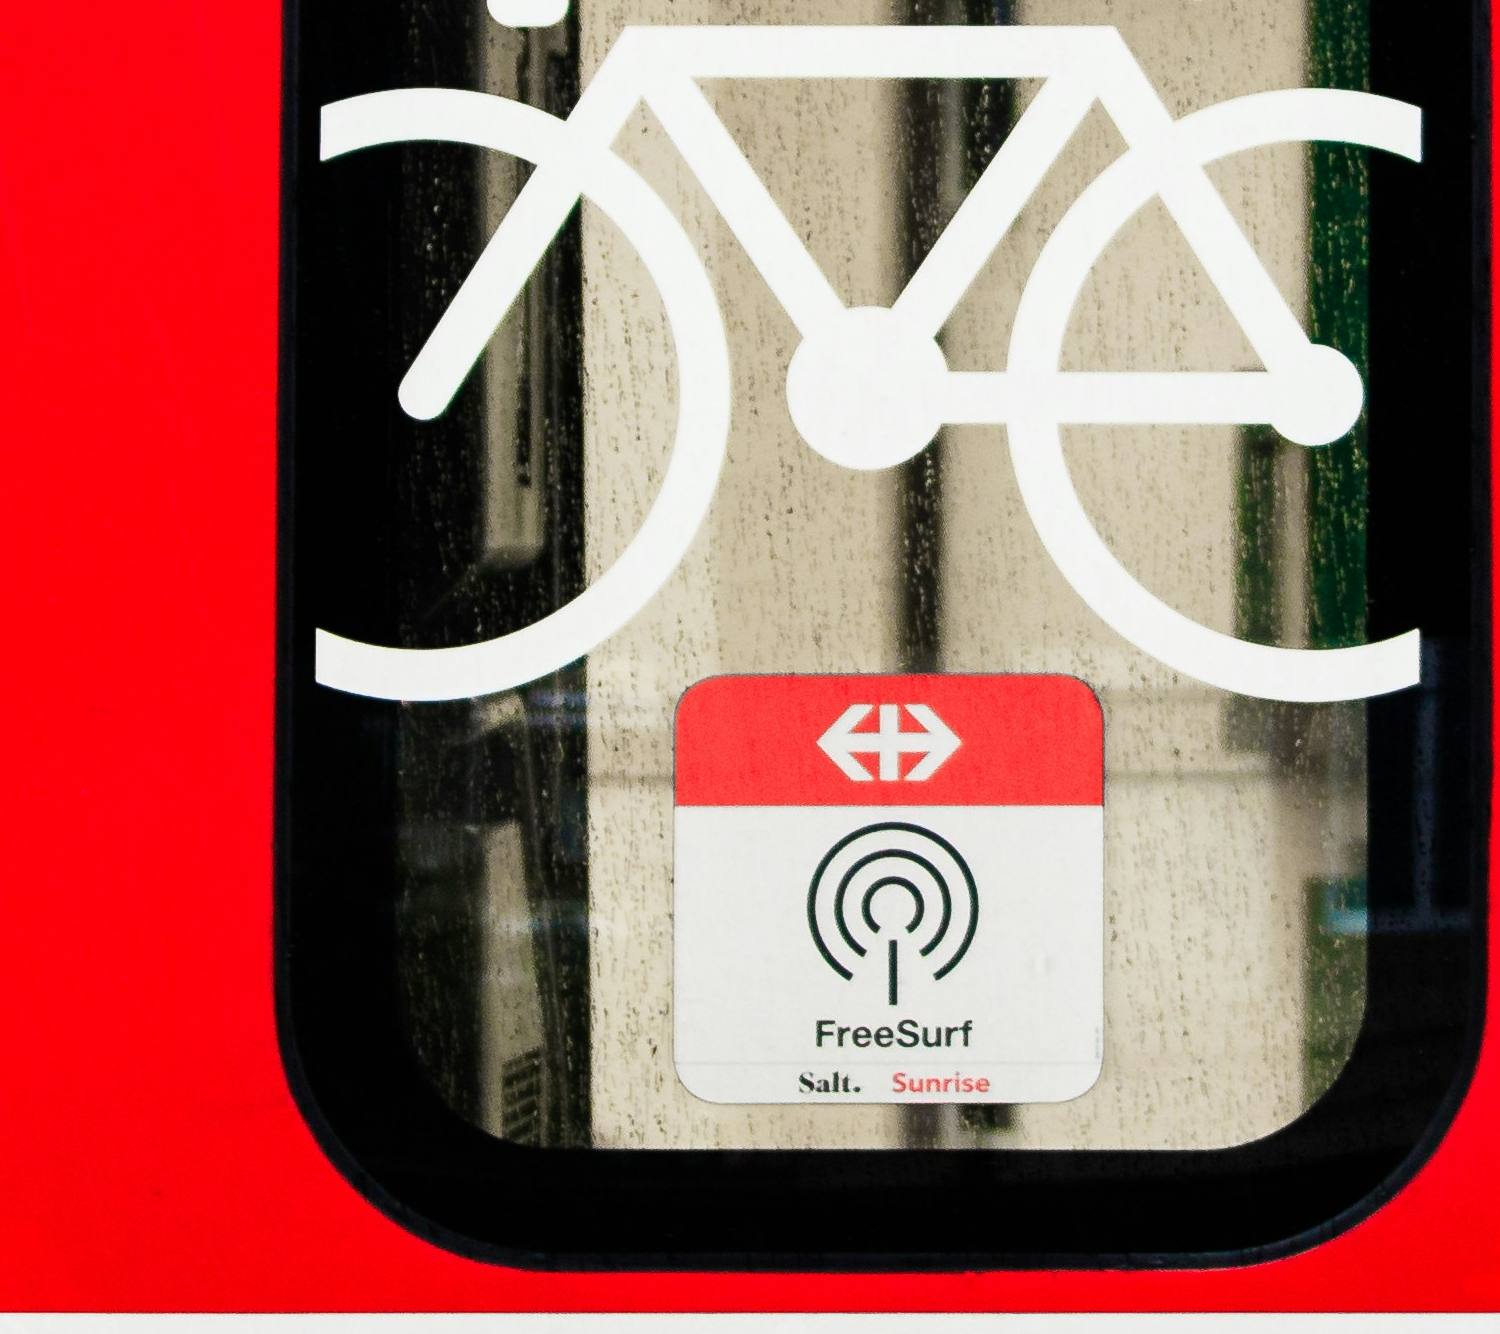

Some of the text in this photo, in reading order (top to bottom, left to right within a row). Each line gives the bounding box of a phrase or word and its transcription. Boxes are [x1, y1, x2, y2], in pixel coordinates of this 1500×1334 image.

[815, 1019, 973, 1048] FreeSurf
[798, 1071, 861, 1094] Salt.
[892, 1071, 991, 1094] Sunrise
